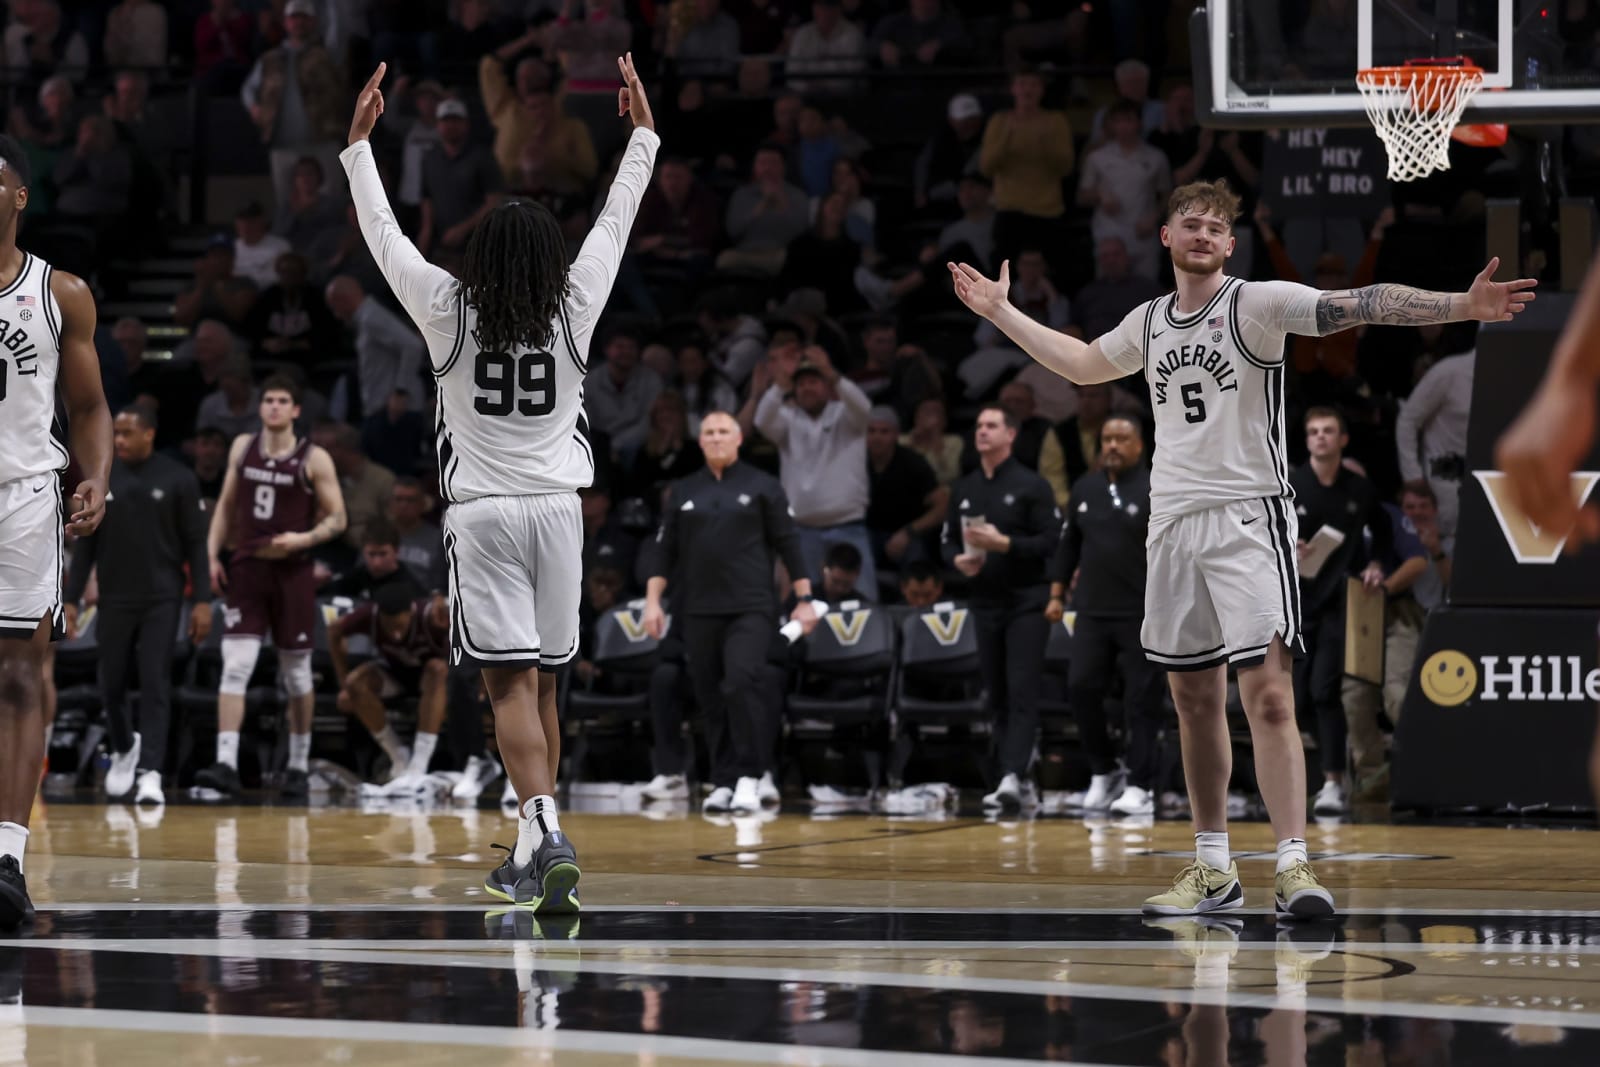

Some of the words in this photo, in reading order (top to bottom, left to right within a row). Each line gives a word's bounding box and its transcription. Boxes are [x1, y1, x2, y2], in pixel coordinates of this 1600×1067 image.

[1287, 128, 1327, 149] HEY
[1321, 147, 1362, 168] HEY
[1329, 173, 1373, 195] BRO
[474, 351, 556, 416] 99
[1155, 344, 1238, 405] VANDERBILT
[1180, 382, 1207, 424] 5
[253, 485, 276, 520] 9
